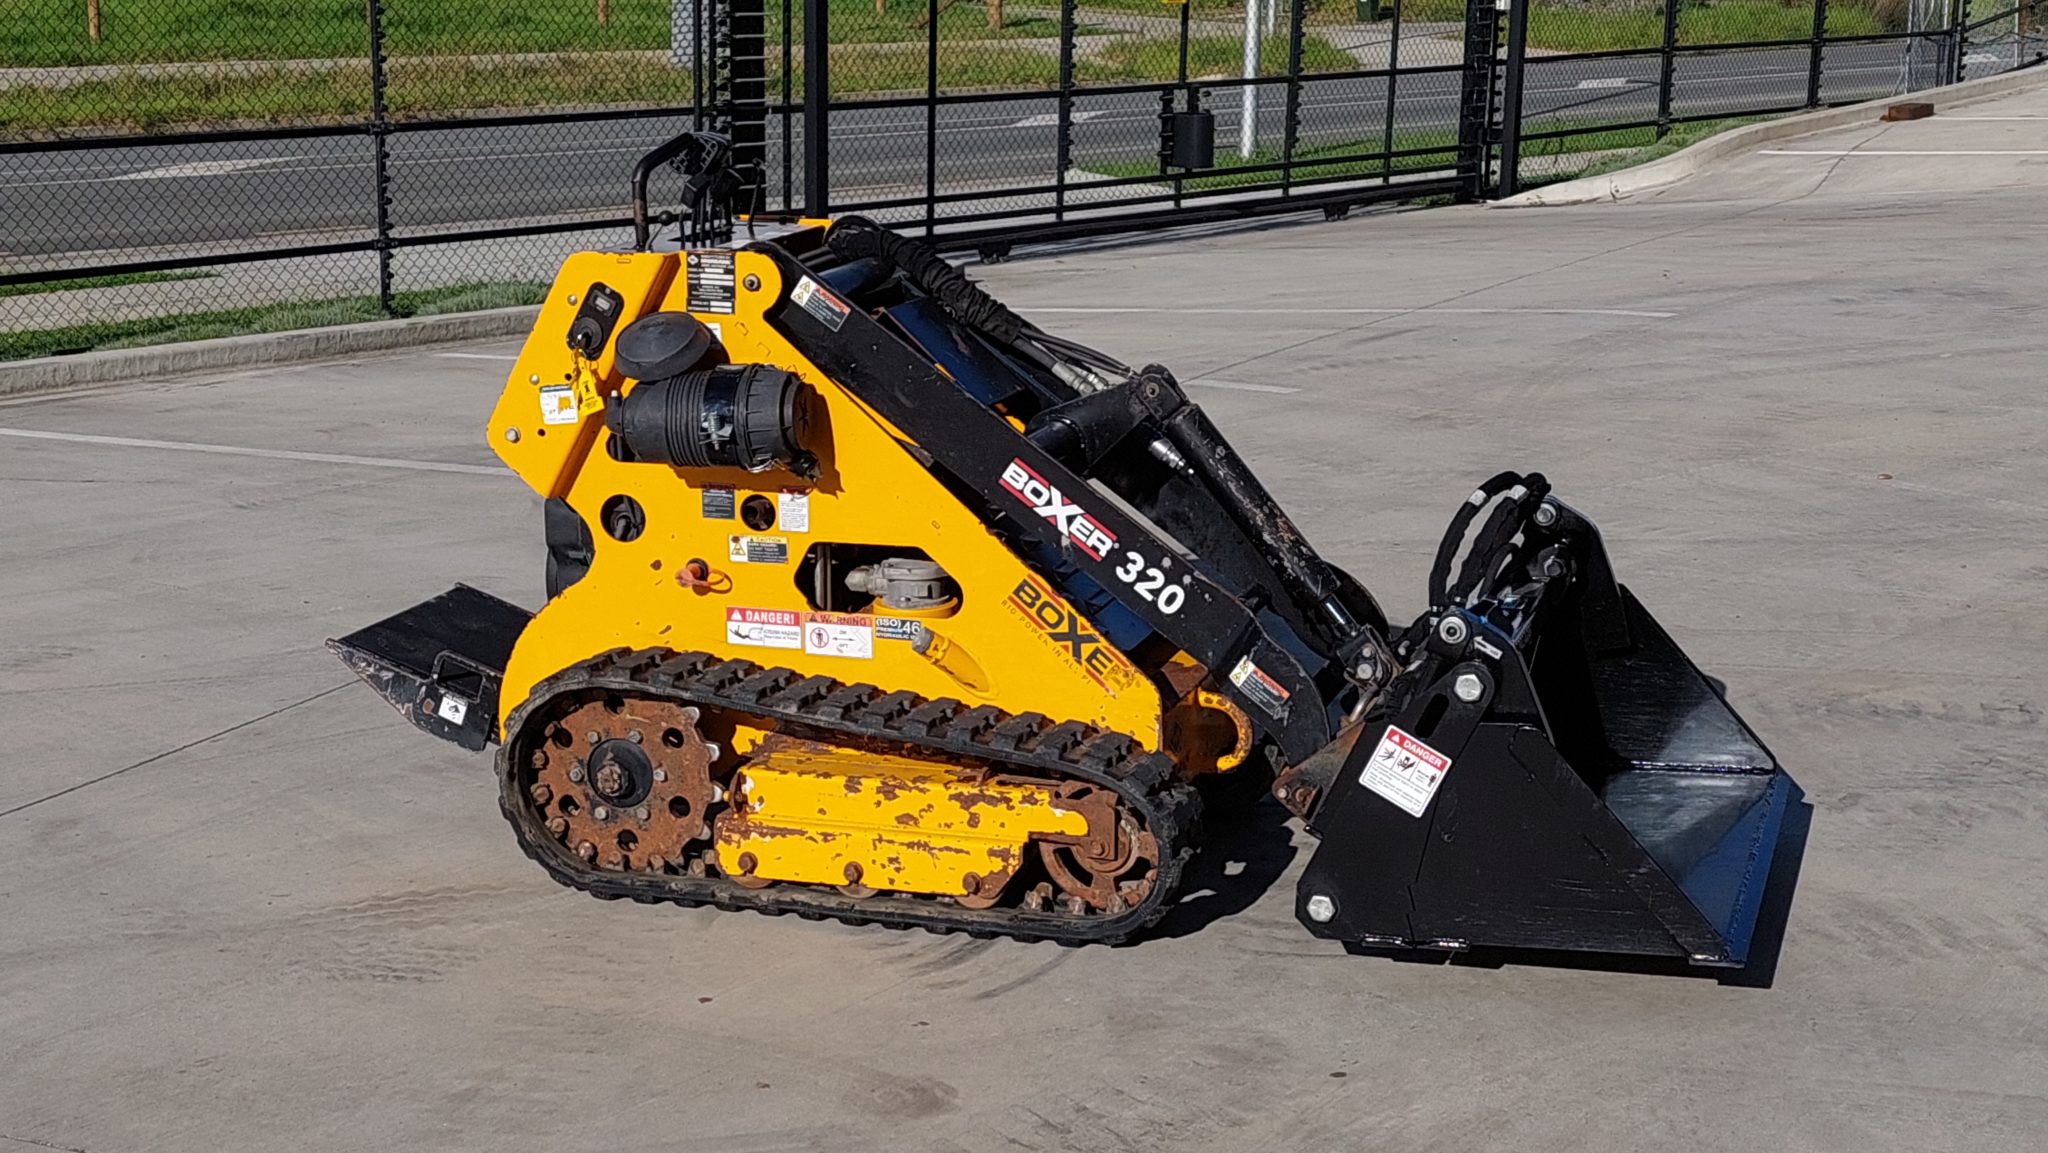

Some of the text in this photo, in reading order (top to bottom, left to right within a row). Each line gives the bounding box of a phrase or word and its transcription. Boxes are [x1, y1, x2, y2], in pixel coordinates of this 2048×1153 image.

[1001, 461, 1185, 614] BOXER 320
[745, 610, 795, 625] DANGER!
[876, 618, 902, 629] (ISO)
[902, 620, 920, 635] 46
[1402, 740, 1442, 767] DANGER
